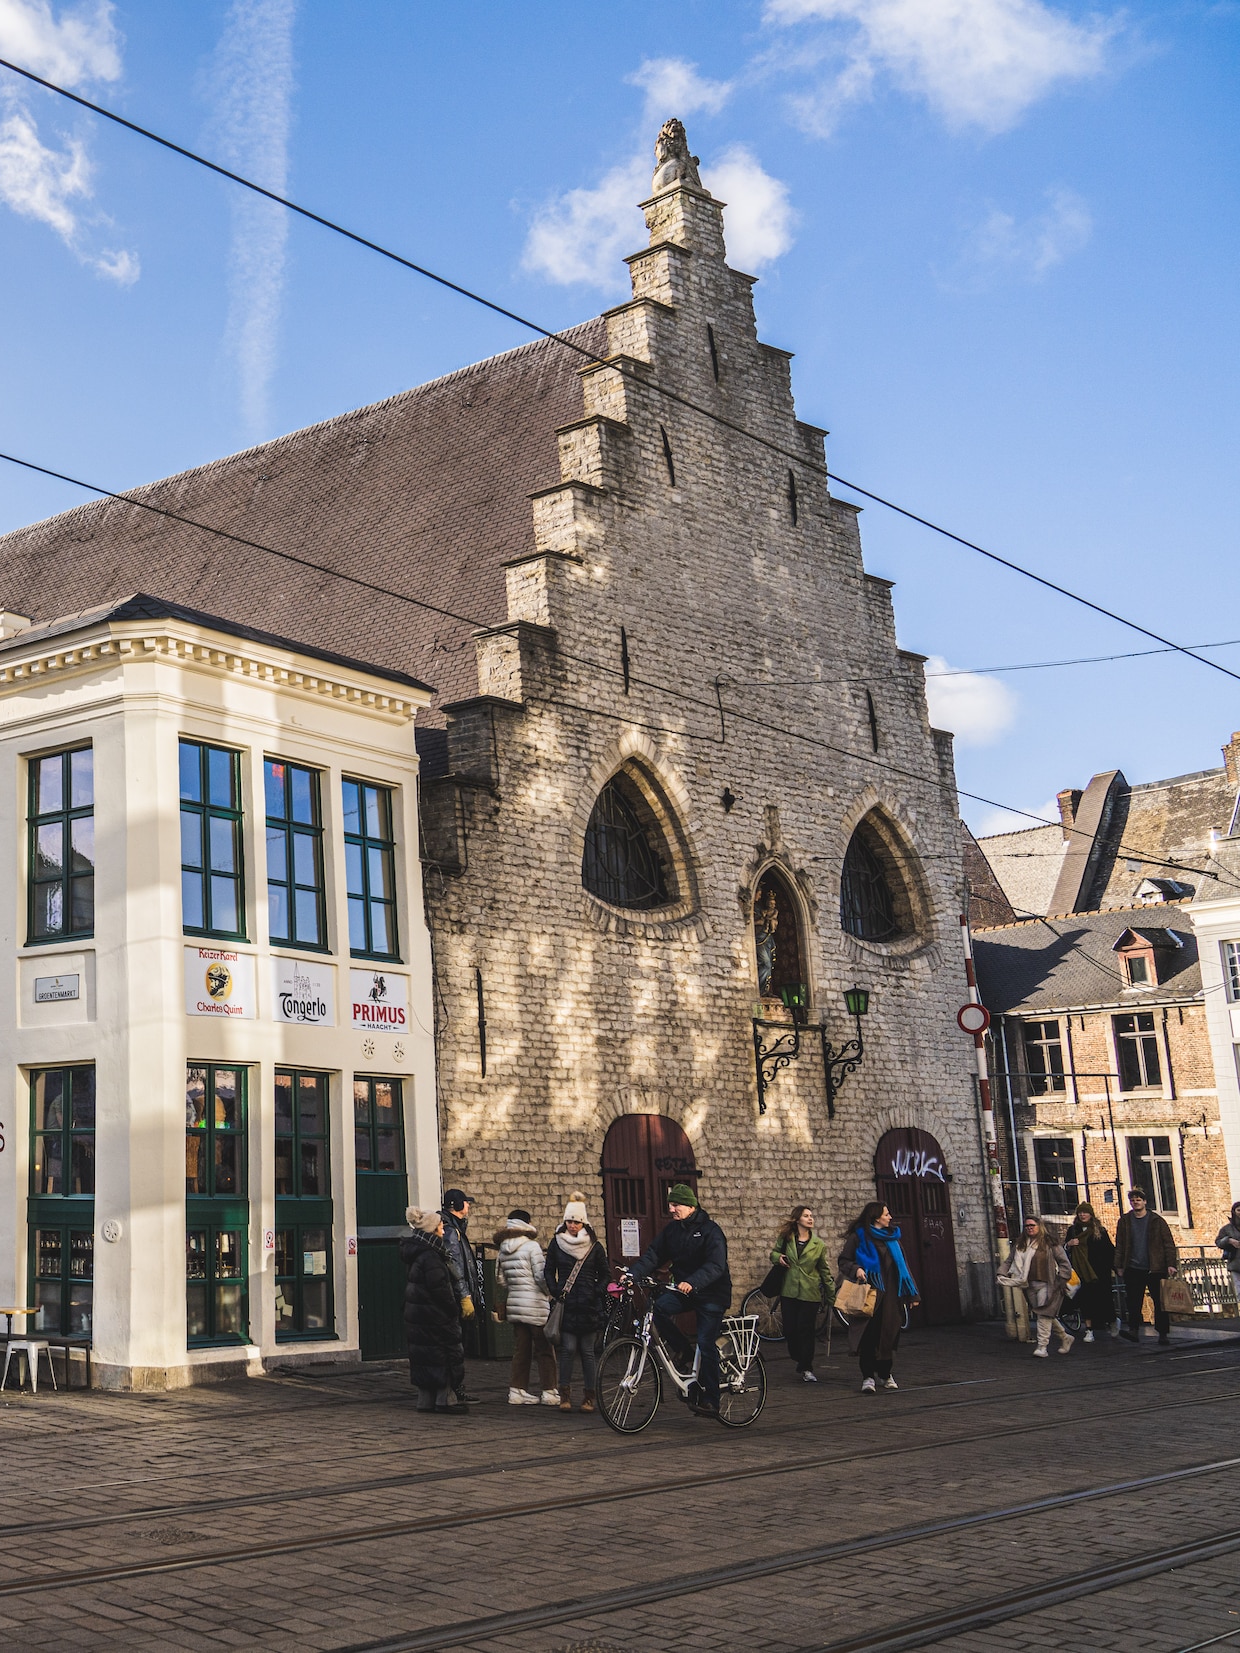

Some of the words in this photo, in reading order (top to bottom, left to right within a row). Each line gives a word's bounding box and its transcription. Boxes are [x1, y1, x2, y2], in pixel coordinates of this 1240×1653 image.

[220, 950, 238, 962] Karel
[38, 989, 77, 1000] GROENTENMARKT
[196, 1001, 223, 1014] Charles
[223, 1003, 243, 1017] Quint
[278, 992, 327, 1022] Tongerlo
[352, 1003, 406, 1025] PRIMUS
